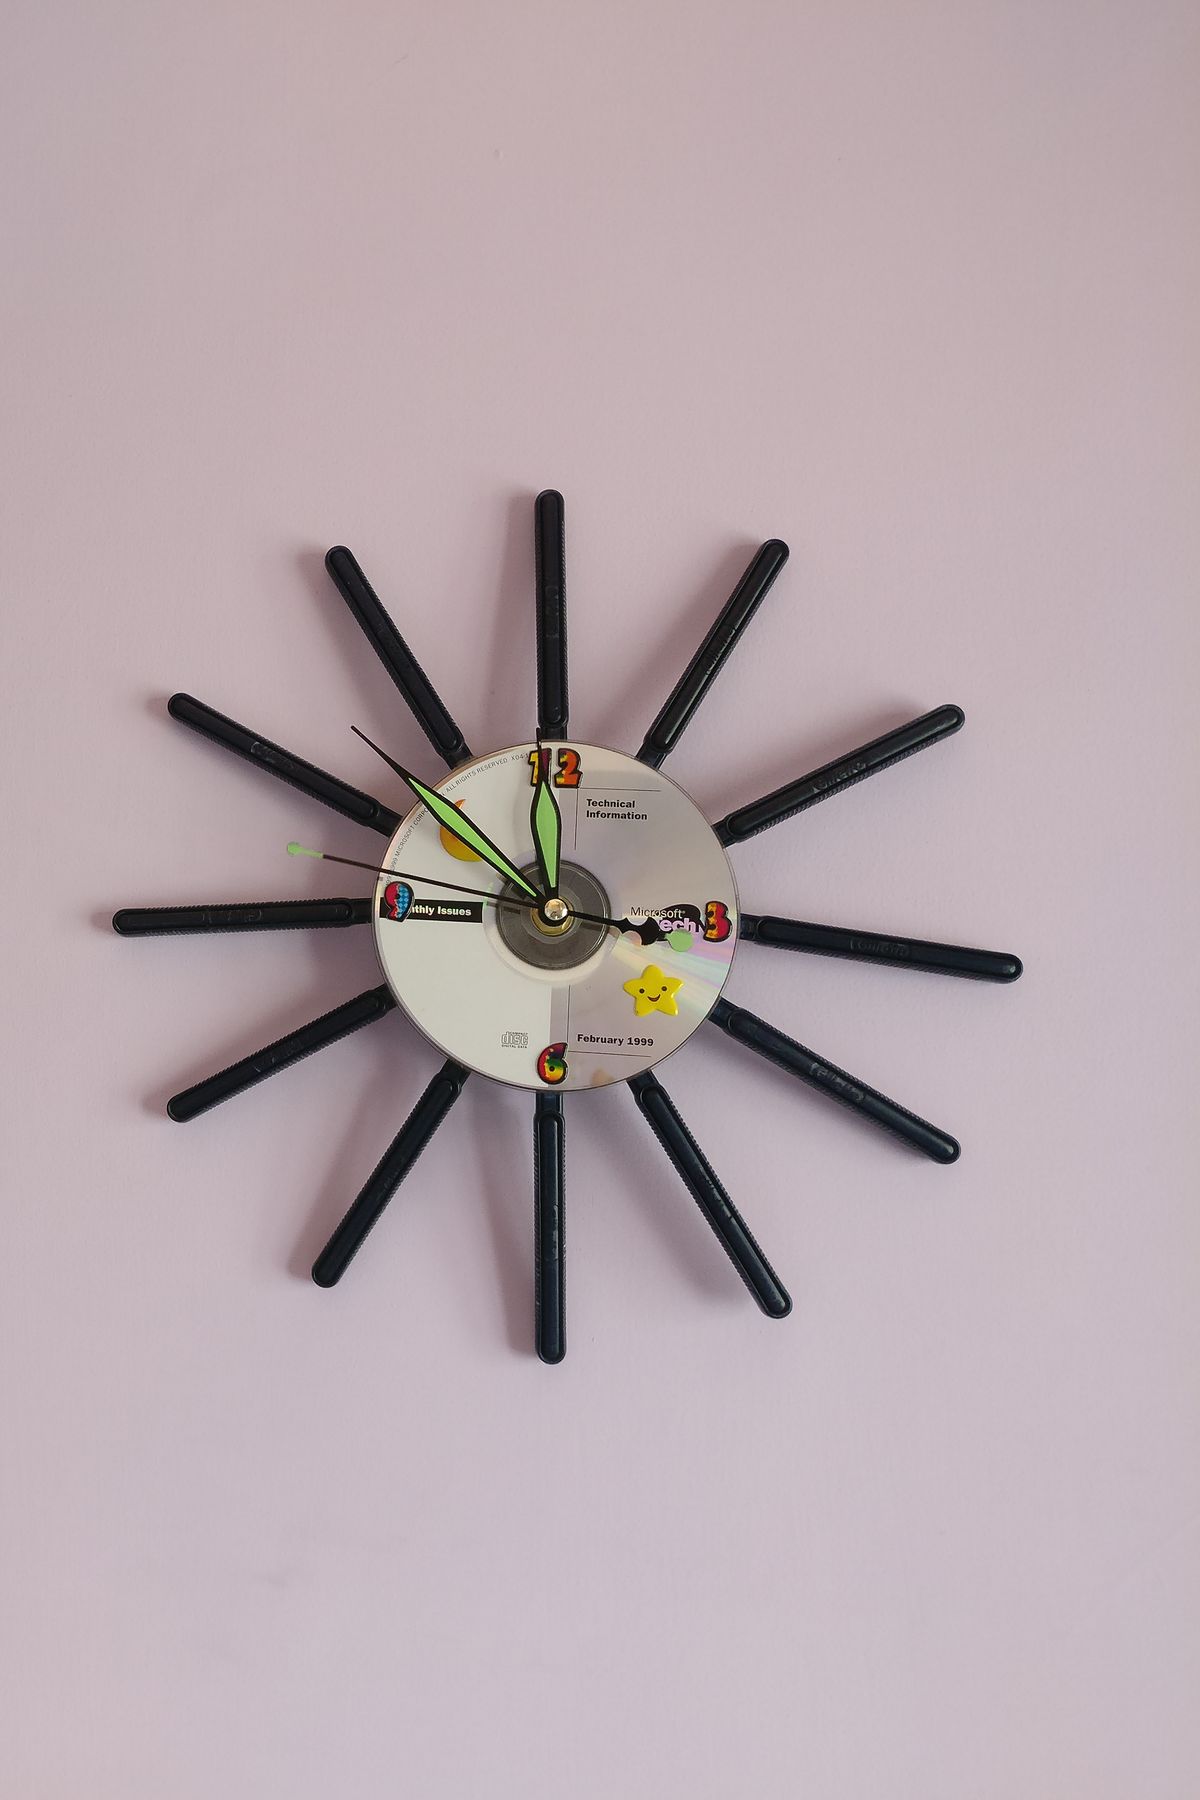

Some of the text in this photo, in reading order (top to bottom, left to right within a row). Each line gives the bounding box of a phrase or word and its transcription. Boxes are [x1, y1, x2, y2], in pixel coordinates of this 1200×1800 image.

[528, 748, 583, 788] 12
[395, 825, 415, 857] MICROSOFT
[477, 757, 508, 773] RESERVED
[586, 798, 636, 809] Technical
[586, 810, 648, 821] Information
[384, 881, 415, 922] 9
[437, 905, 472, 917] Issues
[704, 901, 732, 942] 3
[577, 1033, 654, 1046] February 1999
[537, 1042, 568, 1085] 6
